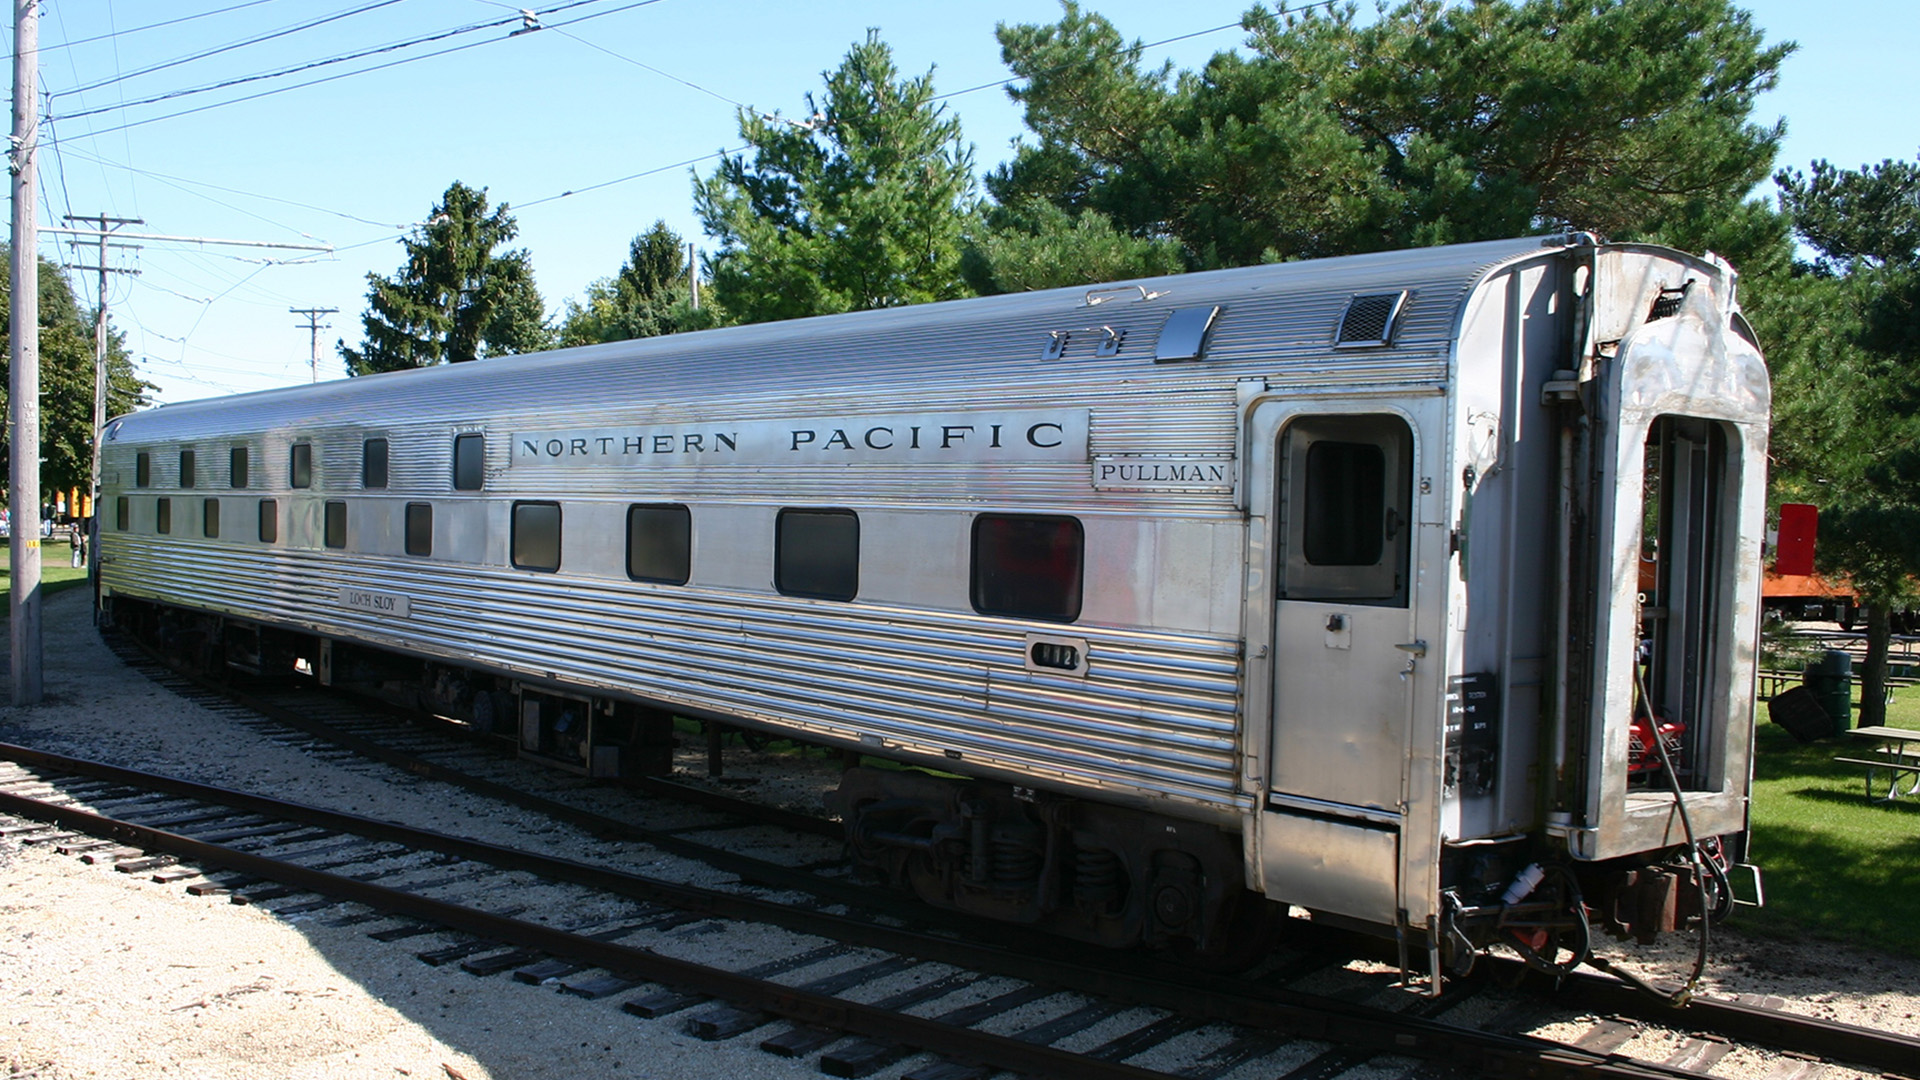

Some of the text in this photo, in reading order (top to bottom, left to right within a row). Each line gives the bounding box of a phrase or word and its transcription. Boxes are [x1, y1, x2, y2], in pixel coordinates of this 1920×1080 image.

[521, 422, 1064, 457] NORTHERN PACIFIC
[1101, 464, 1225, 481] PULLMAN
[349, 592, 396, 611] LOCH SLOY
